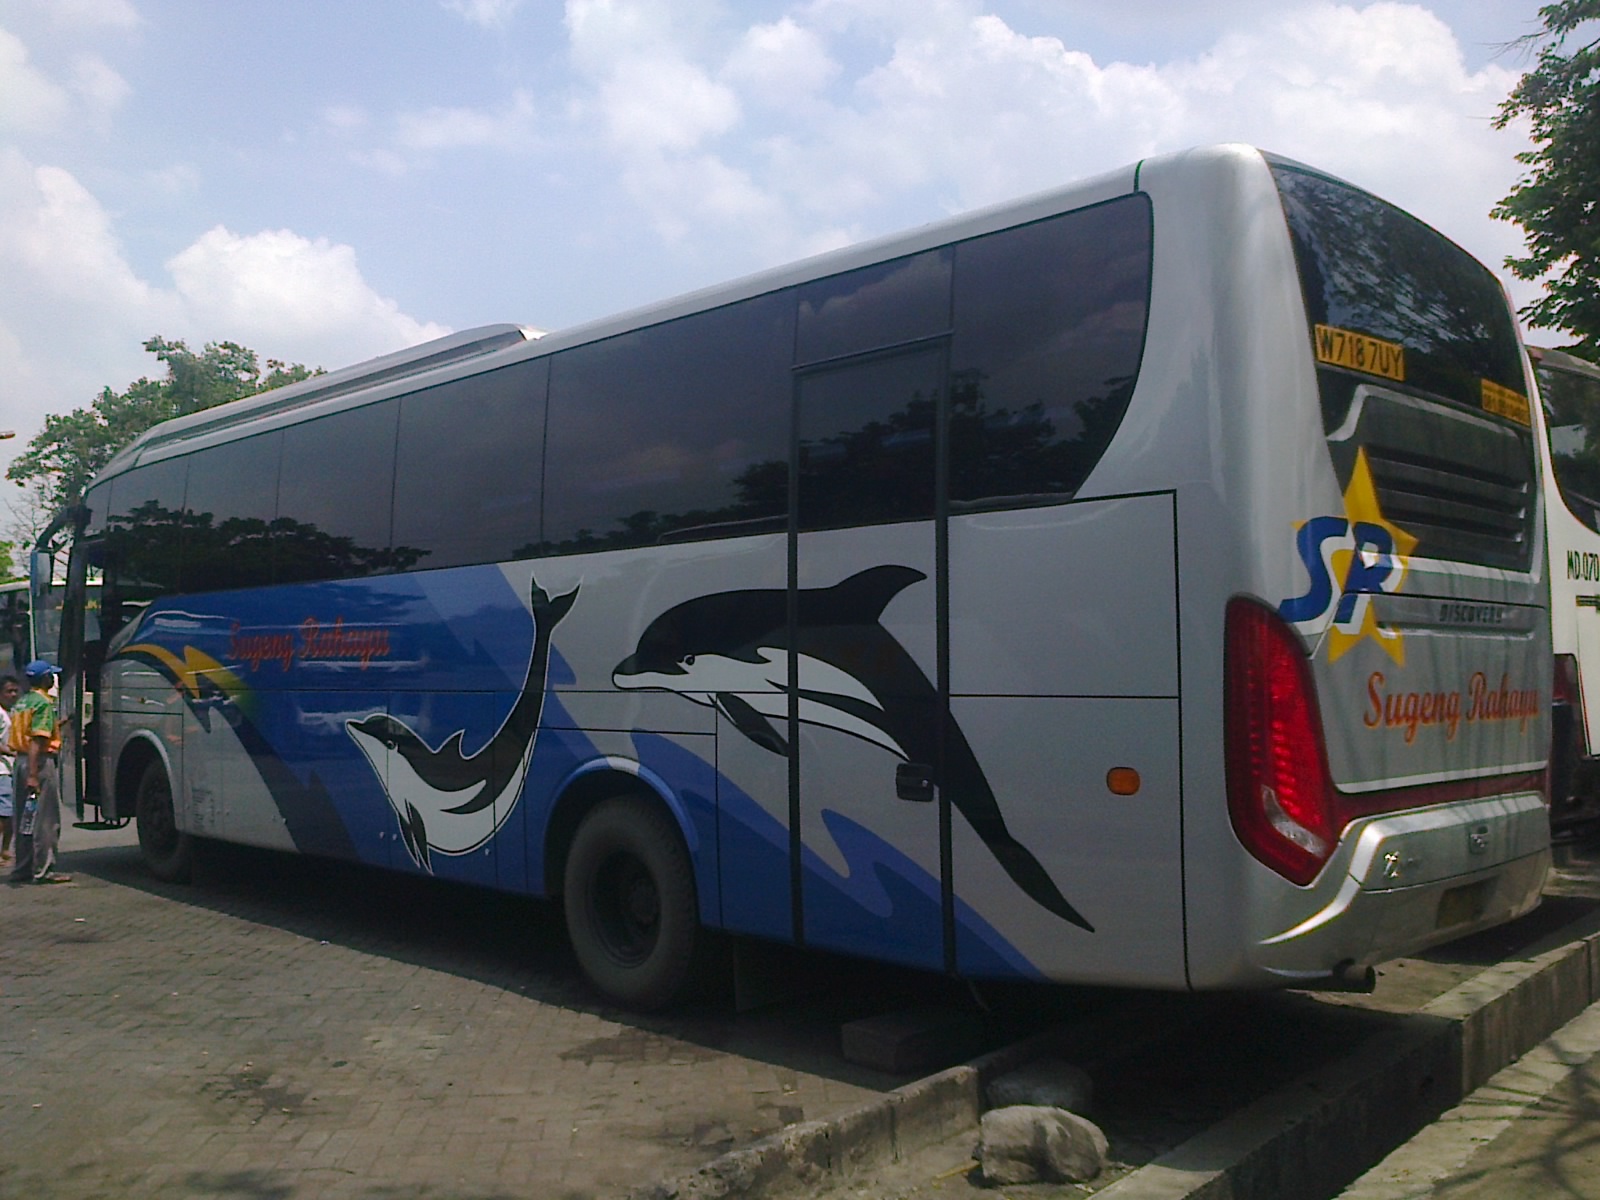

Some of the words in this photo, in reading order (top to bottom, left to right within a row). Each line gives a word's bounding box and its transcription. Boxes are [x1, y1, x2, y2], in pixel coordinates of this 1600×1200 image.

[226, 620, 294, 672] Sugeng
[300, 615, 390, 671] Rahayu
[1363, 671, 1461, 745] Sugeng
[1466, 671, 1540, 736] Rahayu
